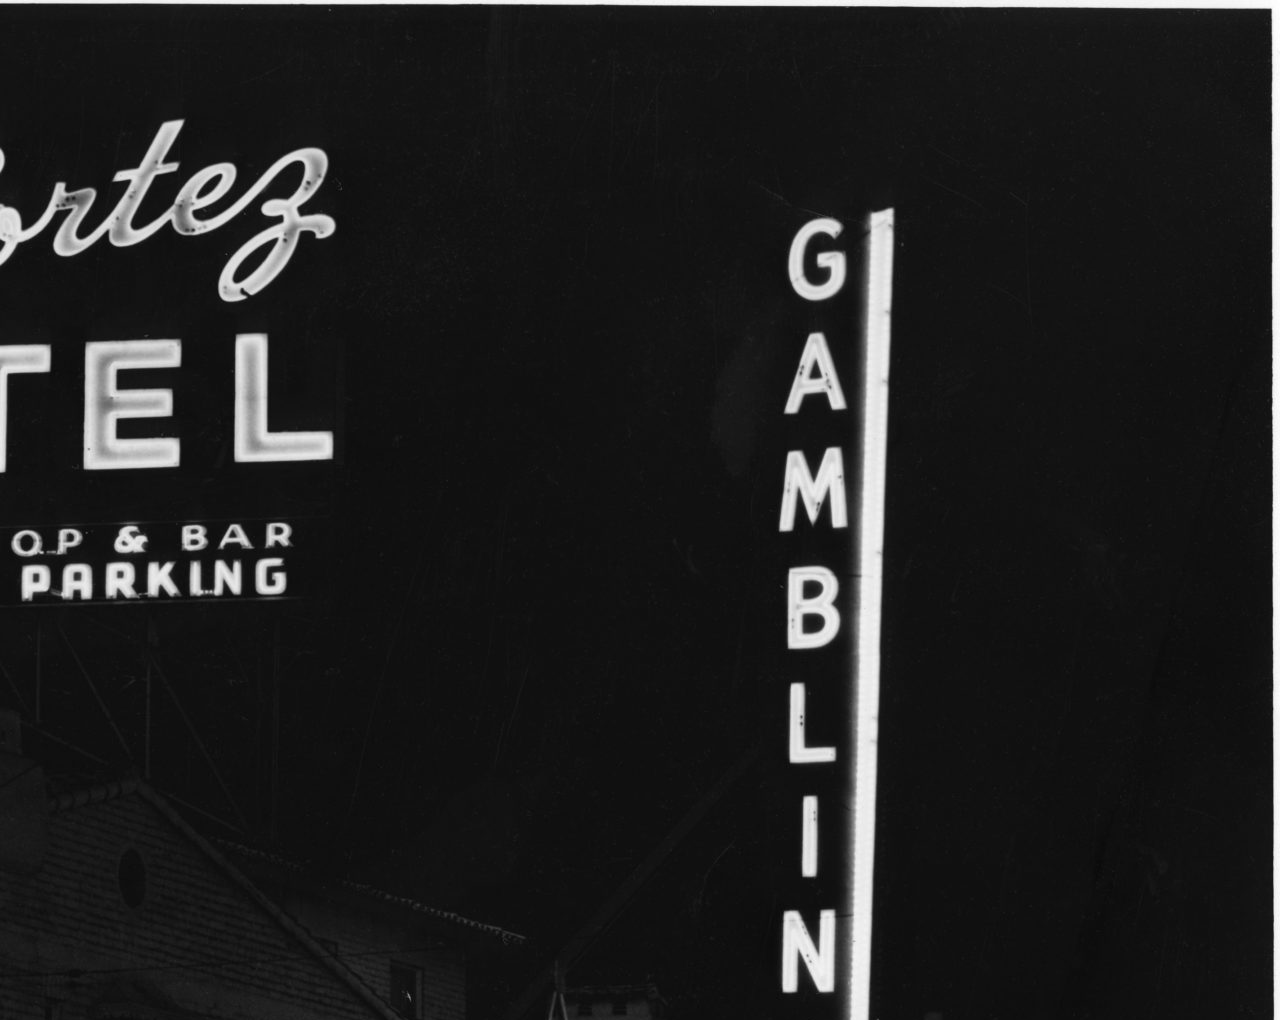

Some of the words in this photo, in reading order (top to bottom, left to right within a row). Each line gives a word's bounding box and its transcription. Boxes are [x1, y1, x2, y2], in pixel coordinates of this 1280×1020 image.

[114, 525, 149, 554] &
[182, 522, 294, 552] BAR
[22, 558, 288, 600] PARKING
